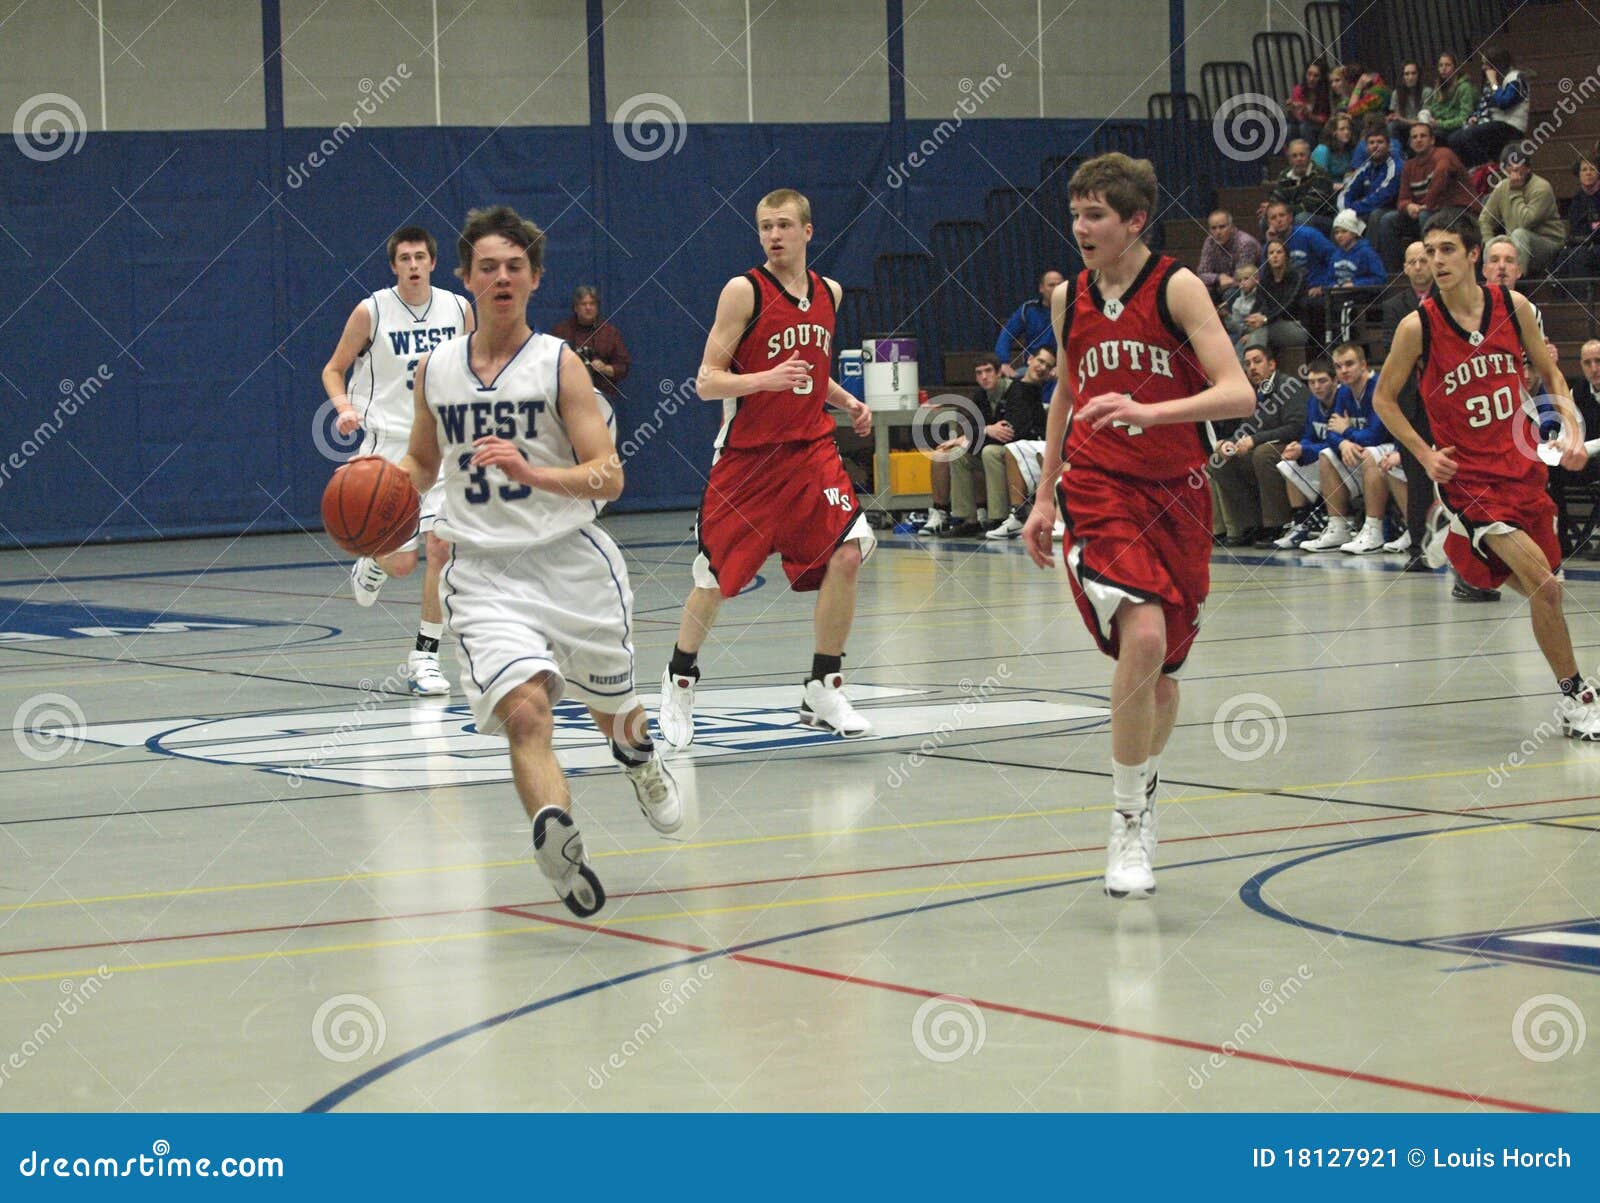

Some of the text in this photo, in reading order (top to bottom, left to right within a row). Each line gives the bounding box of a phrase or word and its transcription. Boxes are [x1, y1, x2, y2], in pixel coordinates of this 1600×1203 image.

[389, 326, 456, 356] WEST
[767, 323, 832, 360] SOUTH
[1078, 339, 1174, 394] SOUTH
[1443, 353, 1517, 396] SOUTH
[437, 400, 546, 445] WEST
[1465, 386, 1514, 428] 30
